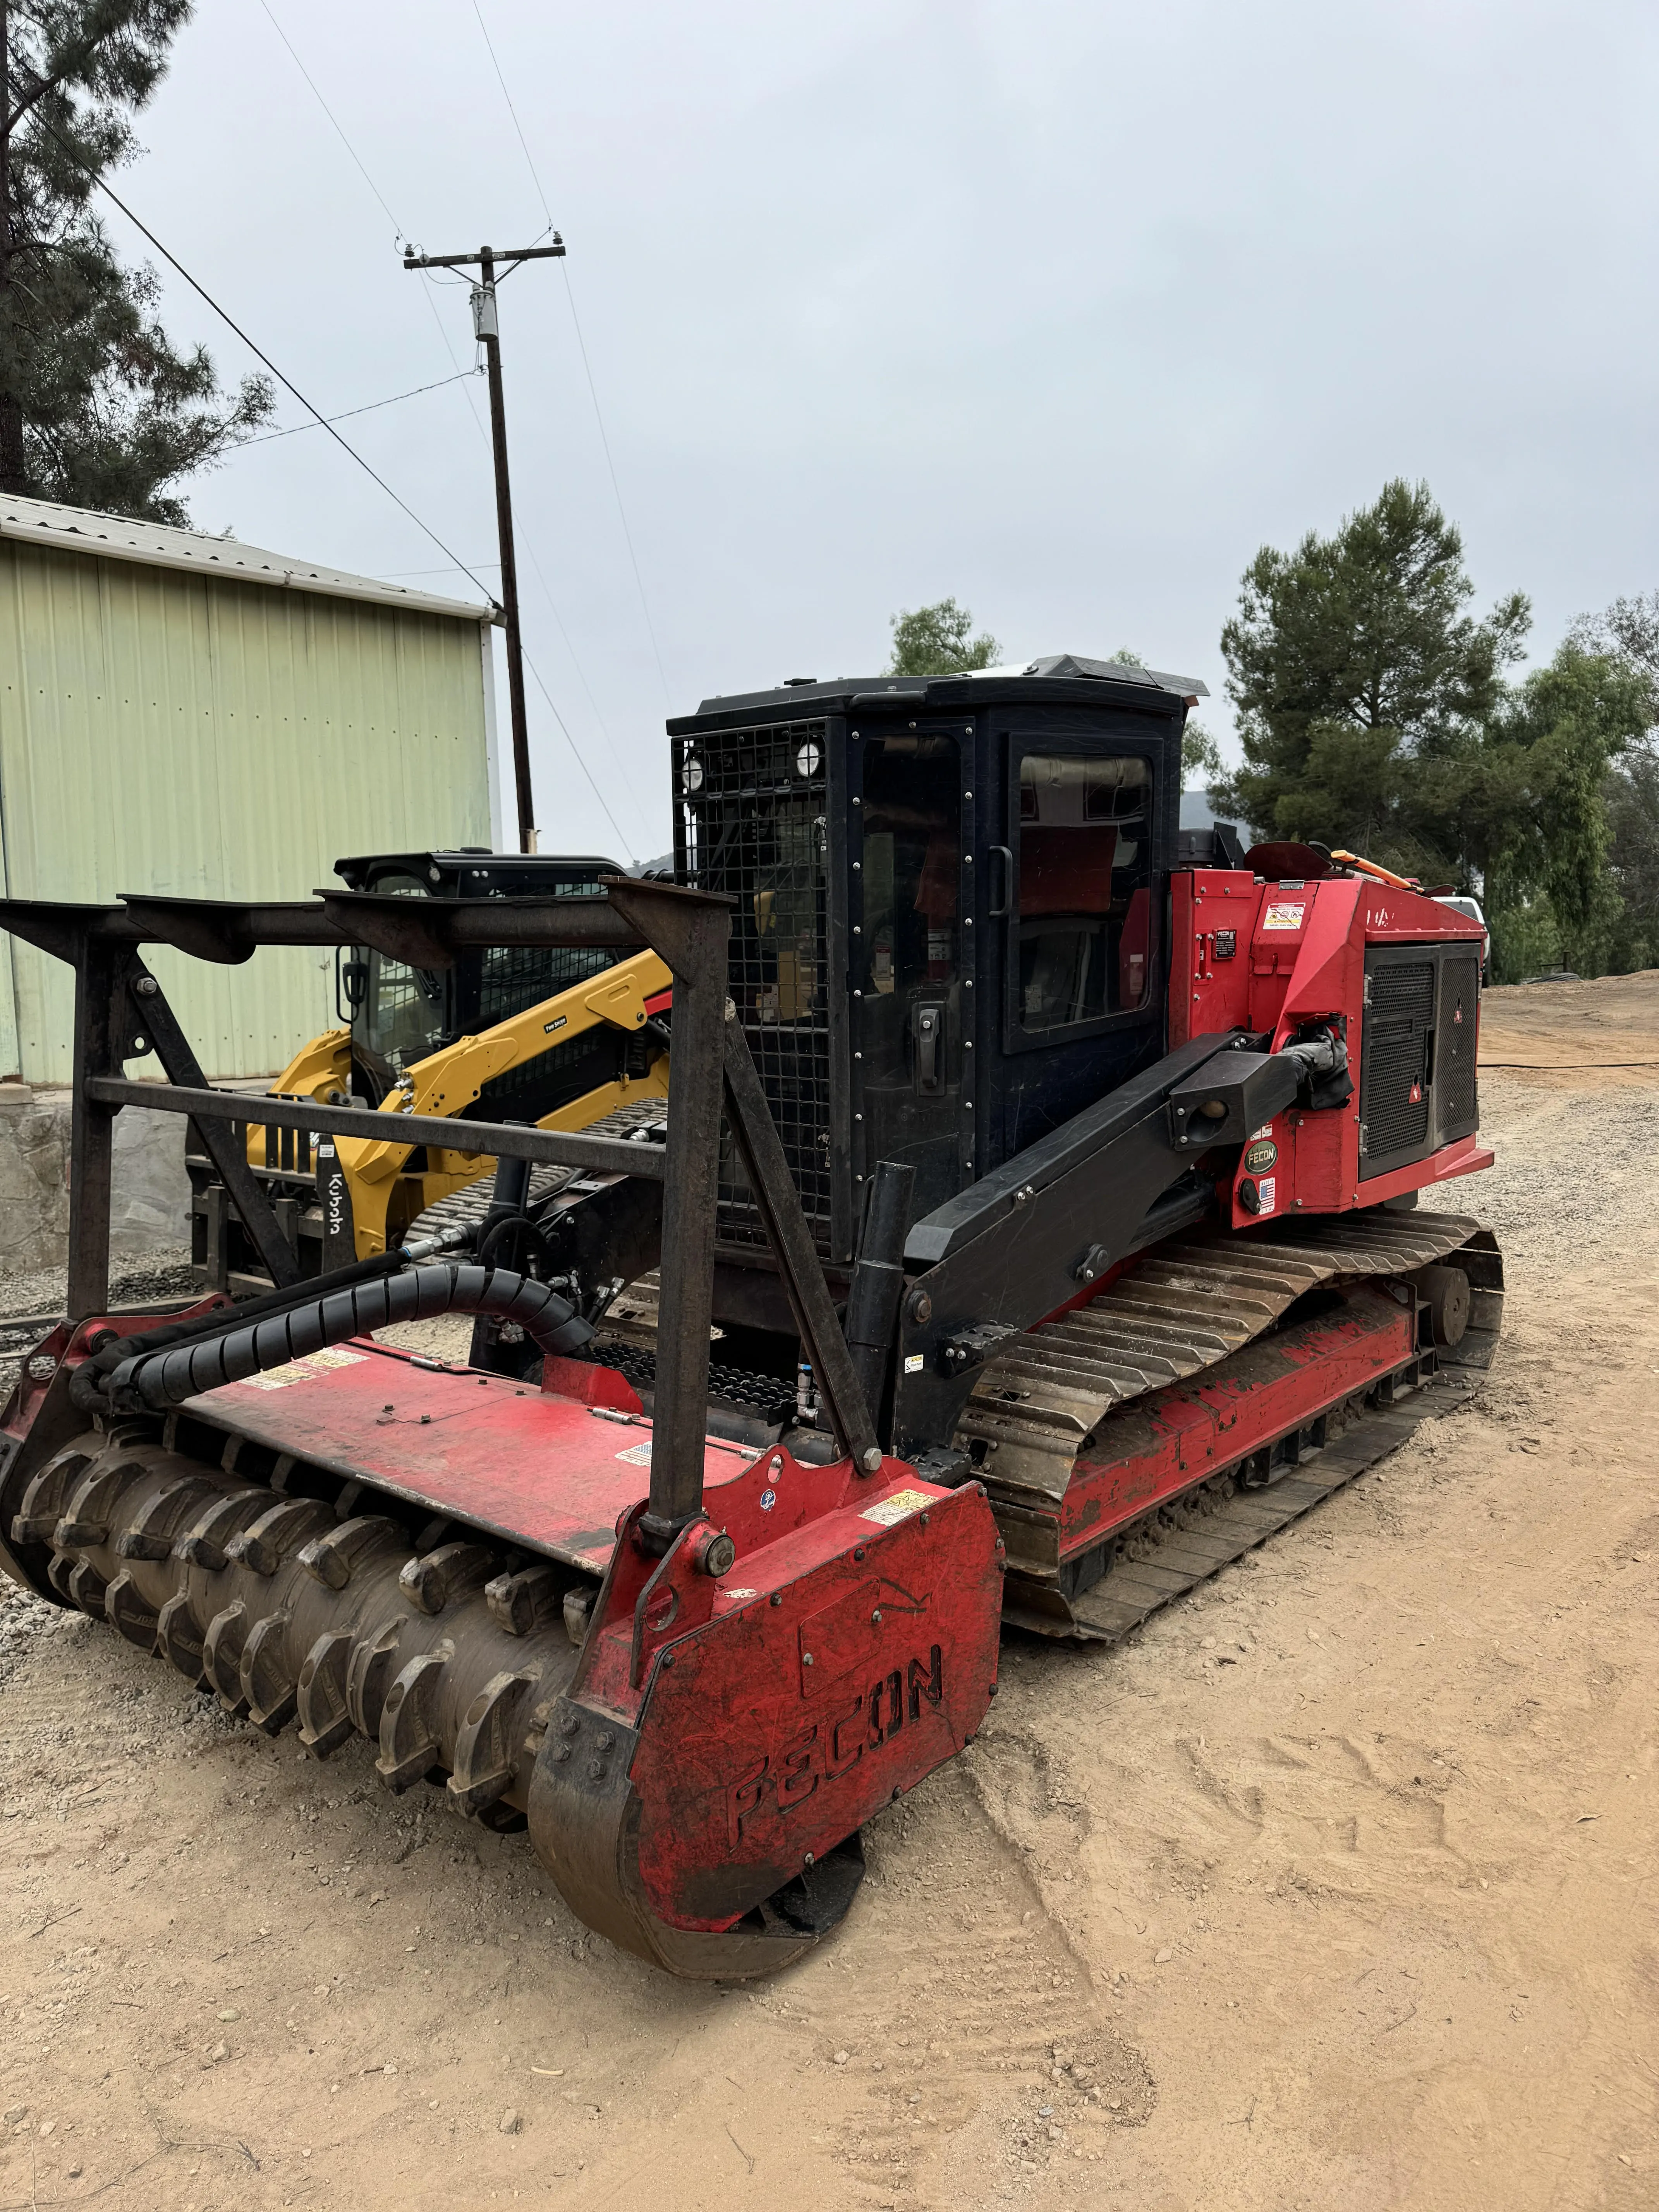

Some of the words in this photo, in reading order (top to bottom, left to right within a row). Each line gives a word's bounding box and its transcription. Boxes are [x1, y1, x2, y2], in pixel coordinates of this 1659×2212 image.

[1249, 1148, 1274, 1165] FECON
[328, 1173, 343, 1235] Kubota
[727, 1644, 943, 1853] FECON
